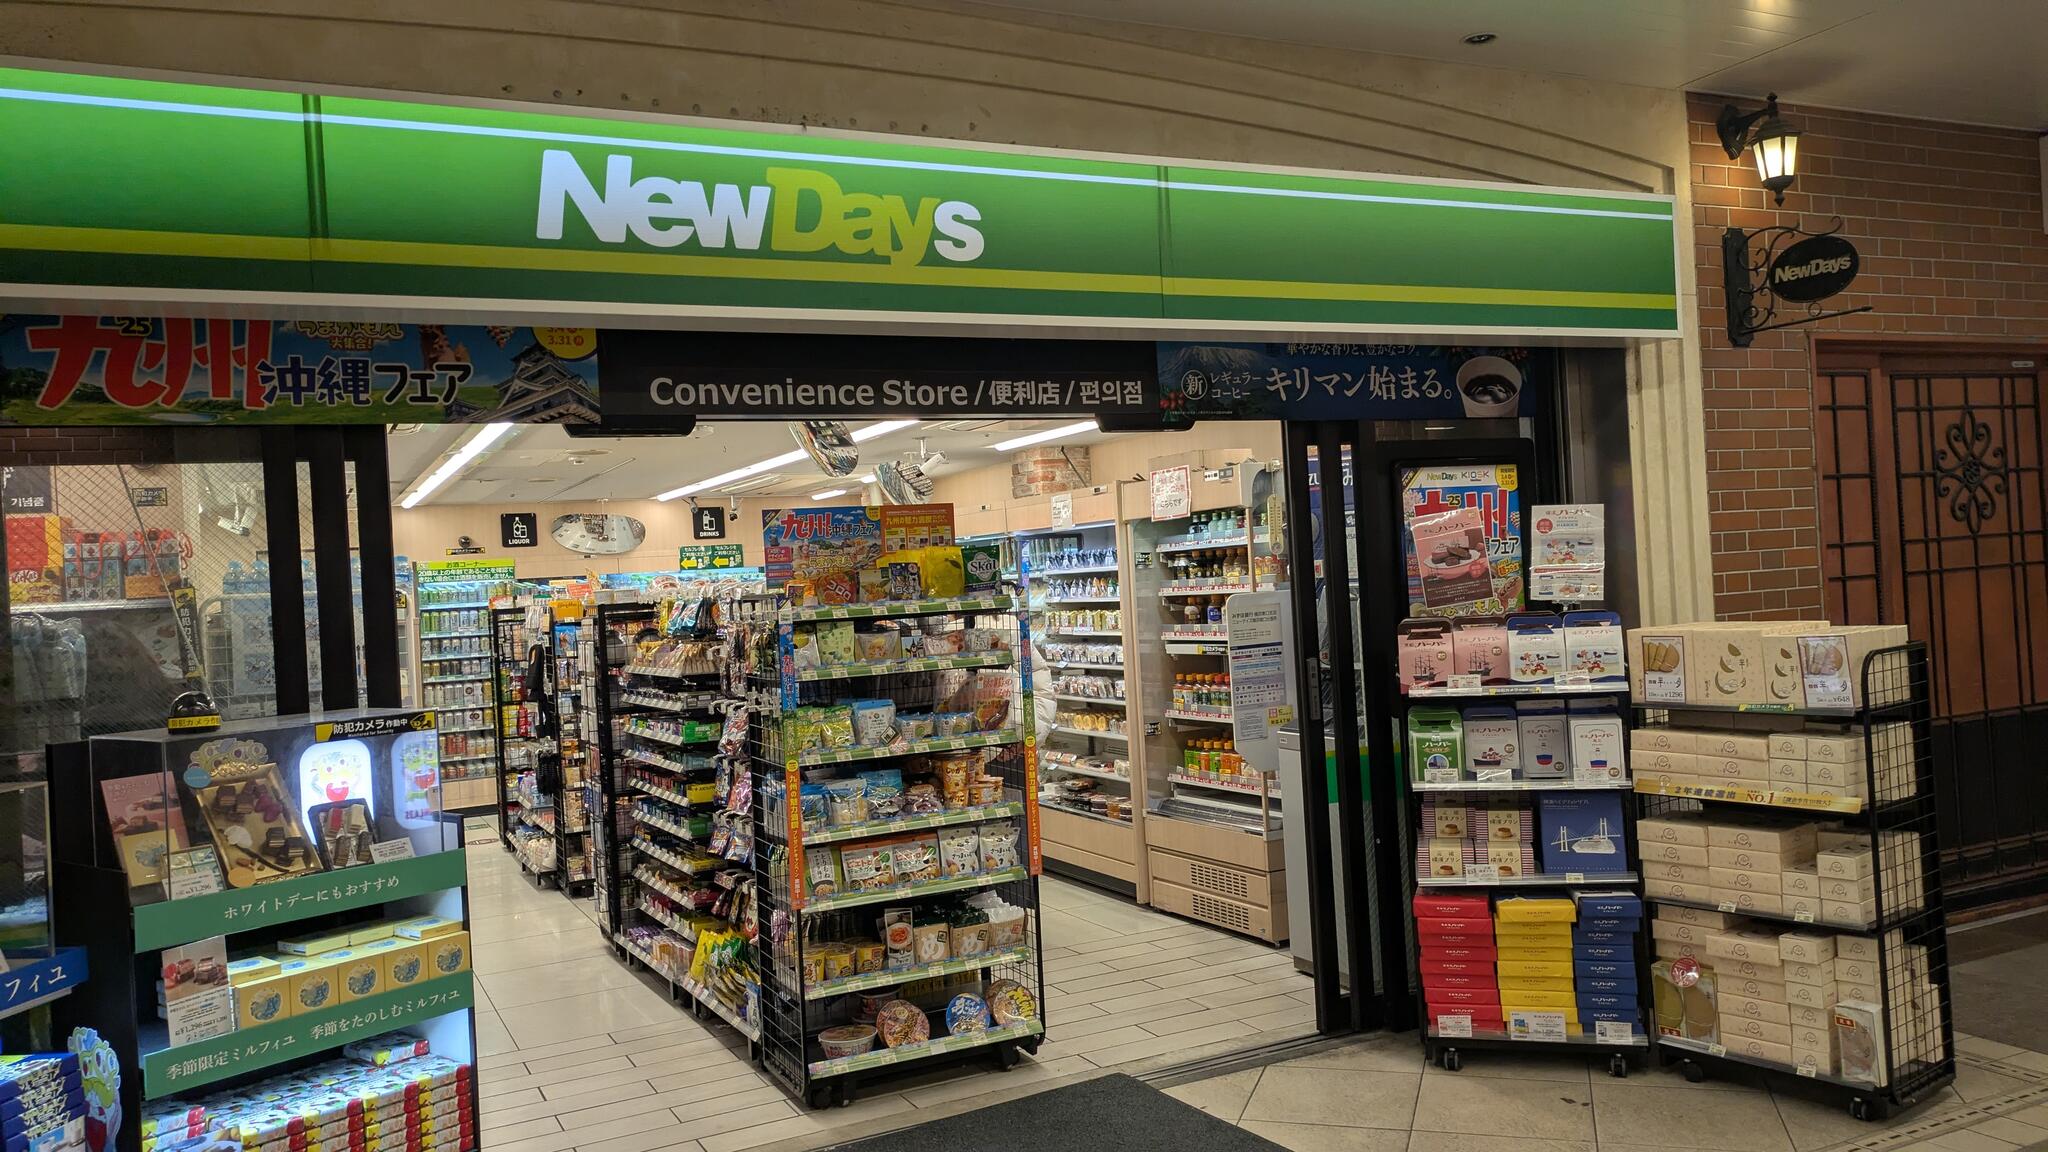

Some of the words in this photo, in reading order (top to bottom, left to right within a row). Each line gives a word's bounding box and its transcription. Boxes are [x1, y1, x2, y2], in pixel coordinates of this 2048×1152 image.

[536, 149, 985, 267] NewDays
[1775, 255, 1852, 284] NewDays
[28, 315, 272, 410] 九州
[256, 355, 473, 406] 沖縄フェア
[650, 377, 875, 406] Convenience
[882, 379, 968, 406] Store
[988, 380, 1061, 405] 便利店
[1080, 379, 1144, 405] 편의점
[1185, 374, 1203, 396] 新
[1210, 372, 1262, 385] レギュラー
[1265, 366, 1453, 402] キリマン始まる。
[1210, 388, 1251, 400] コーヒー
[508, 537, 530, 545] LIQUOR
[781, 512, 832, 541] 九州
[224, 876, 400, 920] ホワイトデーにもおすすめ
[310, 989, 460, 1039] 季節をたのしむミルフィユ
[166, 1034, 296, 1080] 季節限定ミルフィユ
